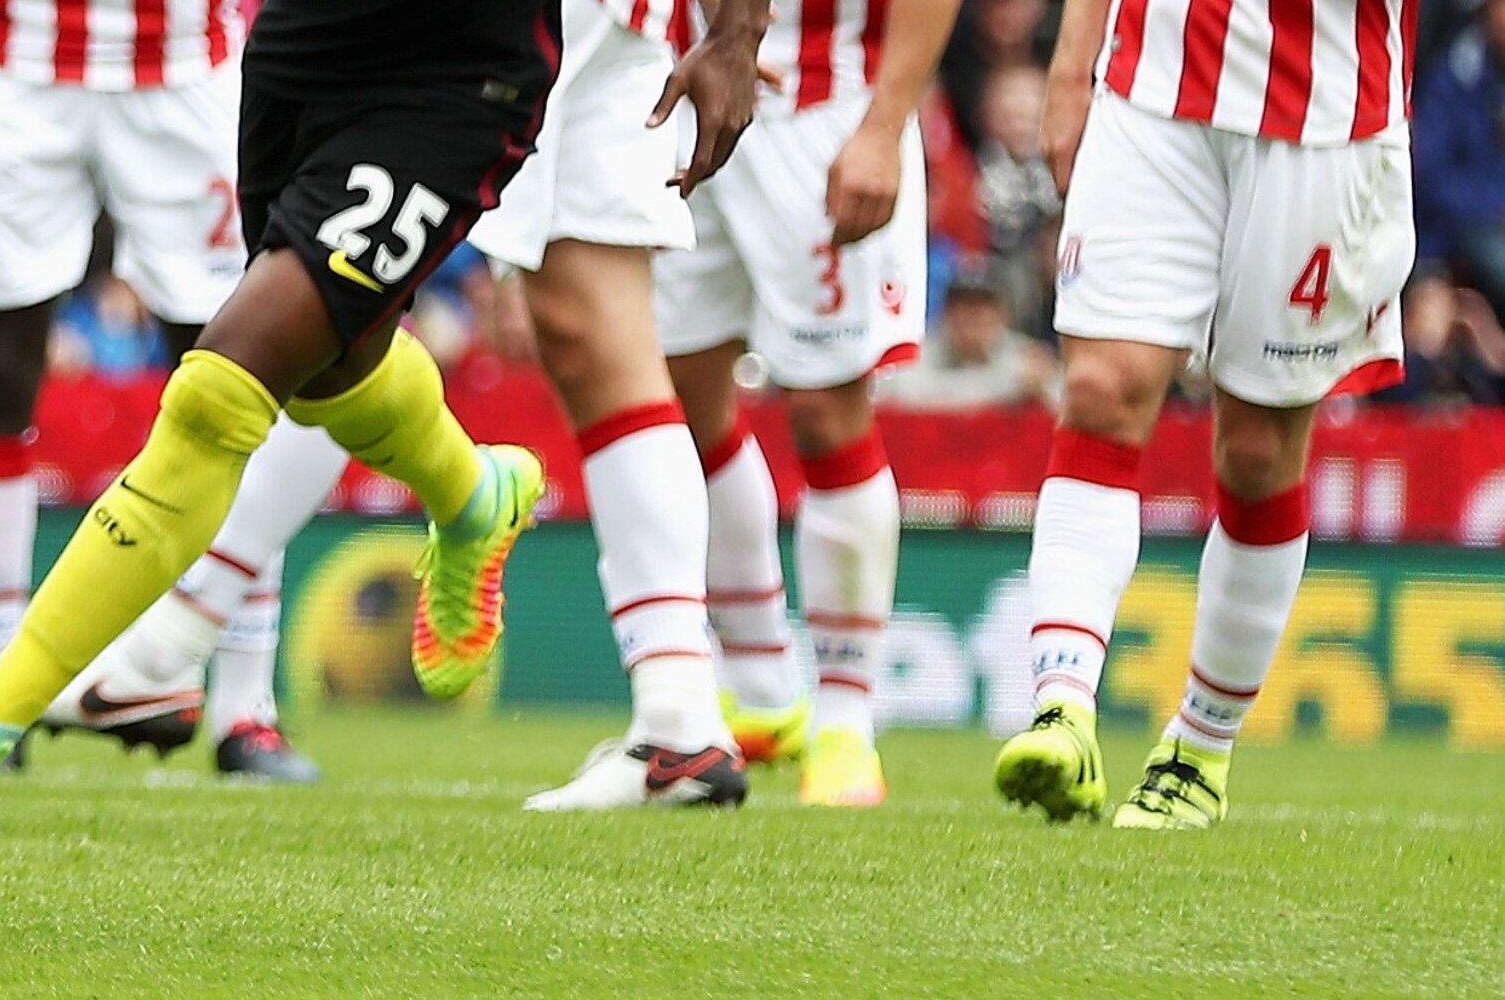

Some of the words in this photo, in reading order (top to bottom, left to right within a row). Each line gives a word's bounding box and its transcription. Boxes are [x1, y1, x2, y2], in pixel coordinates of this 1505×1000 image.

[315, 162, 451, 284] 25
[810, 242, 844, 317] 3
[1287, 241, 1334, 328] 4
